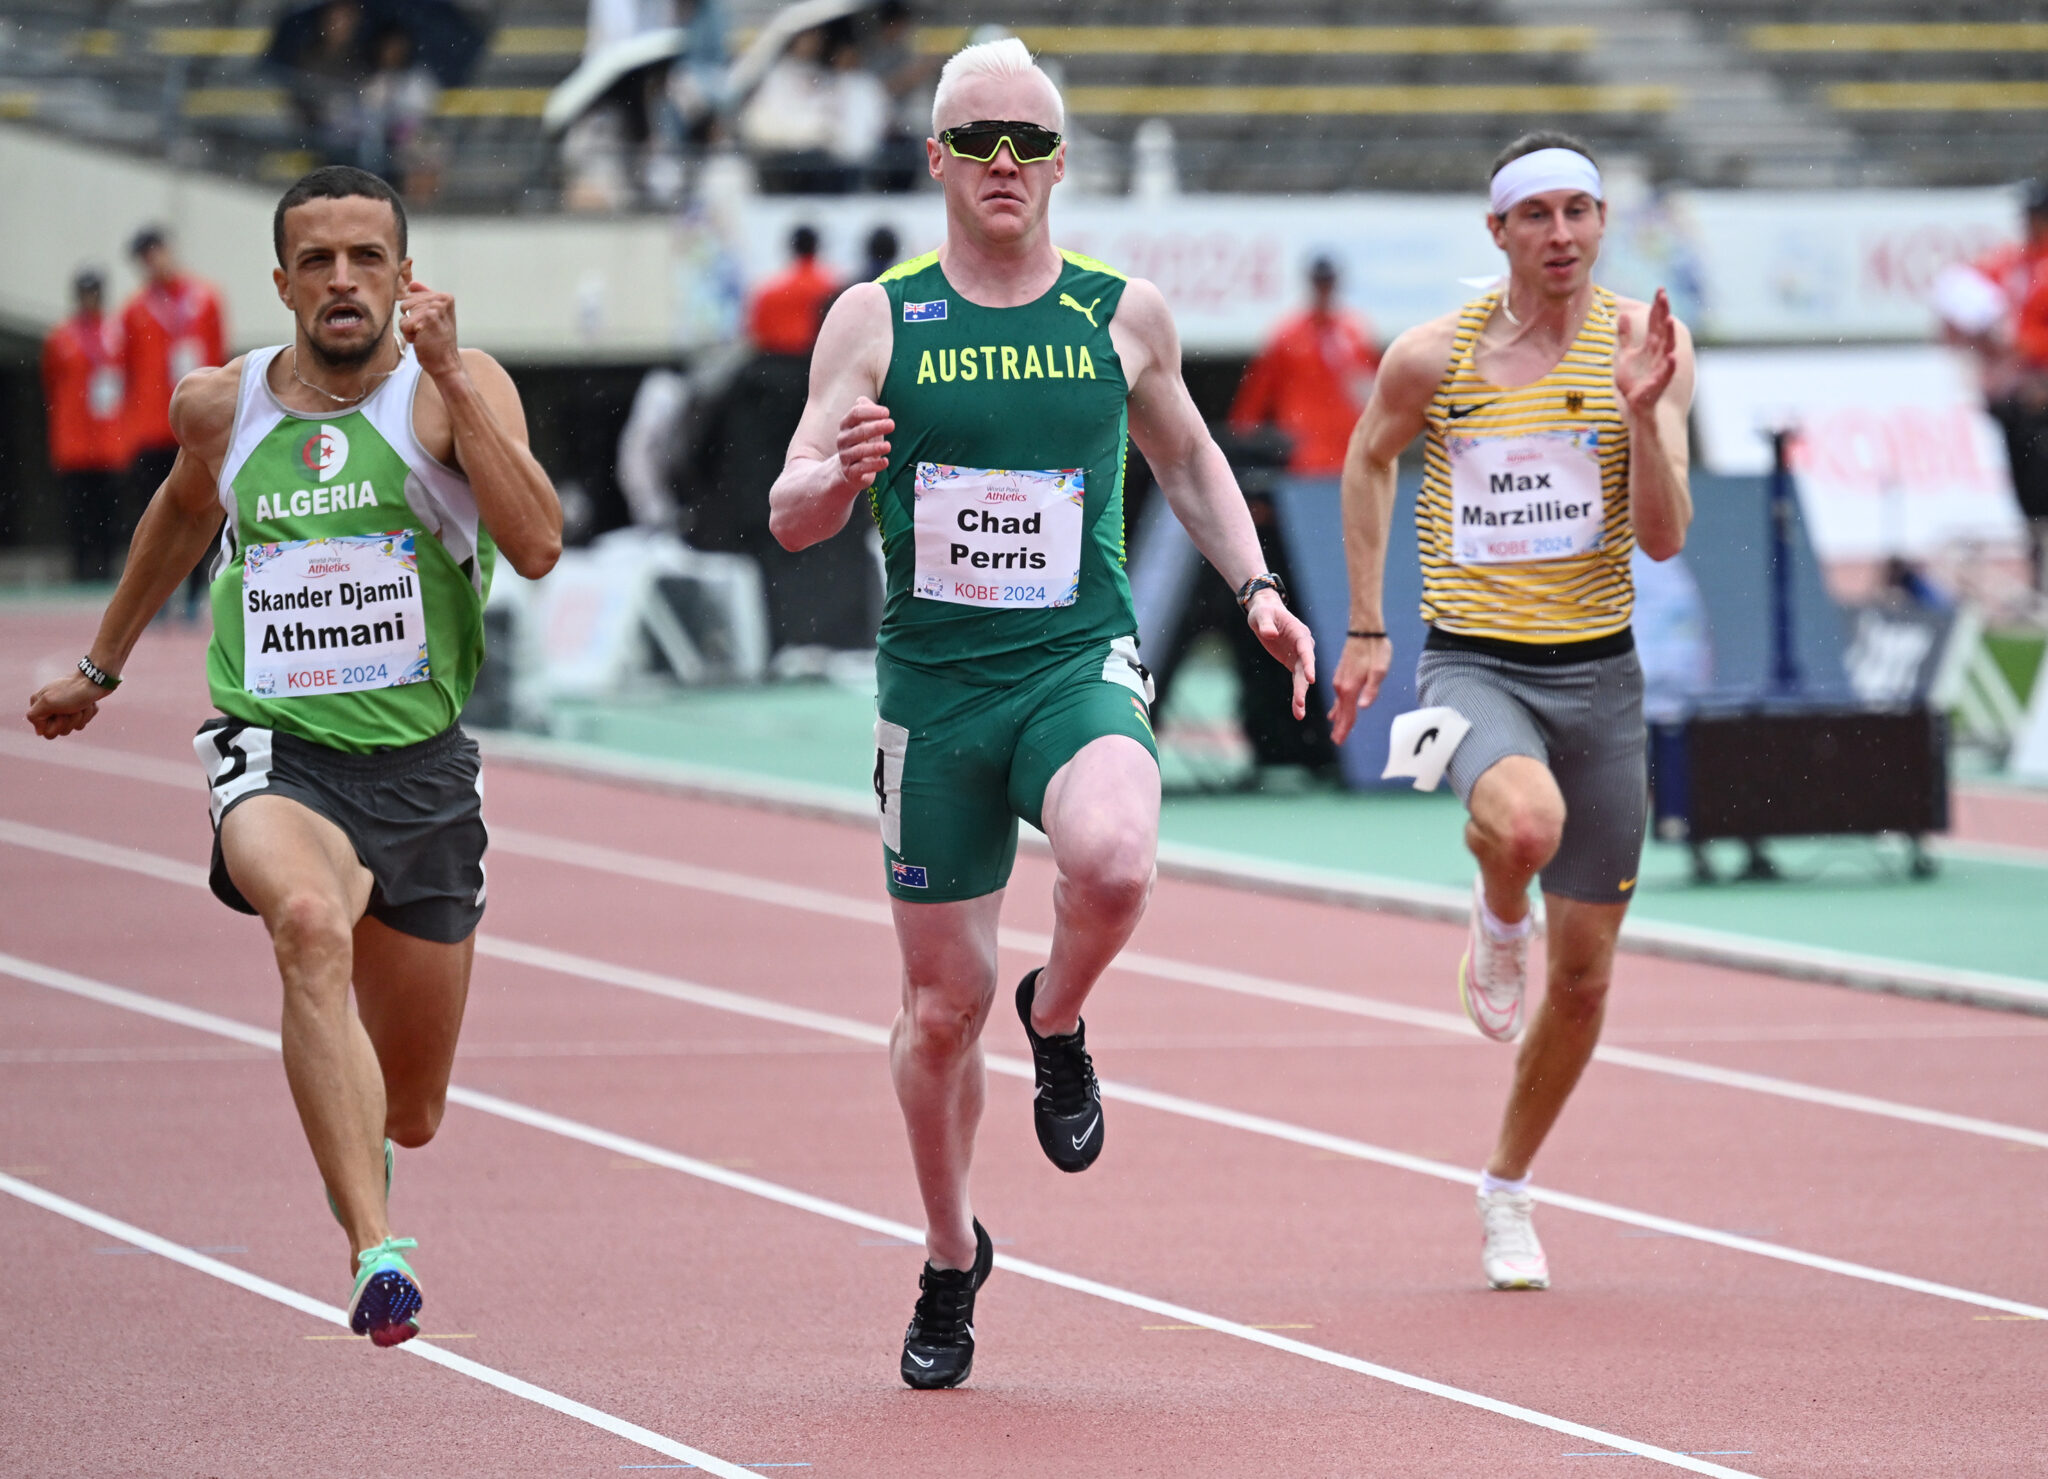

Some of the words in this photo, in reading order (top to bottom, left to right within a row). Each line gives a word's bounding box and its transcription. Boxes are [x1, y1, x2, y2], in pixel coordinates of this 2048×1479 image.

[917, 345, 1096, 384] AUSTRALIA
[1490, 473, 1551, 494] Max
[256, 480, 378, 523] ALGERIA
[985, 492, 1027, 502] Athletics
[957, 509, 1041, 534] Chad
[1462, 501, 1592, 526] Marzillier
[950, 543, 1046, 569] Perris
[1488, 539, 1529, 555] KOBE
[1533, 536, 1573, 553] 2024
[308, 563, 350, 574] Athletics
[248, 586, 332, 612] Skander
[340, 575, 413, 610] Djamil
[955, 582, 999, 600] KOBE
[1004, 586, 1046, 600] 2024
[261, 612, 404, 653] Athmani
[288, 669, 338, 688] KOBE
[342, 664, 388, 684] 2024
[213, 726, 247, 788] 5
